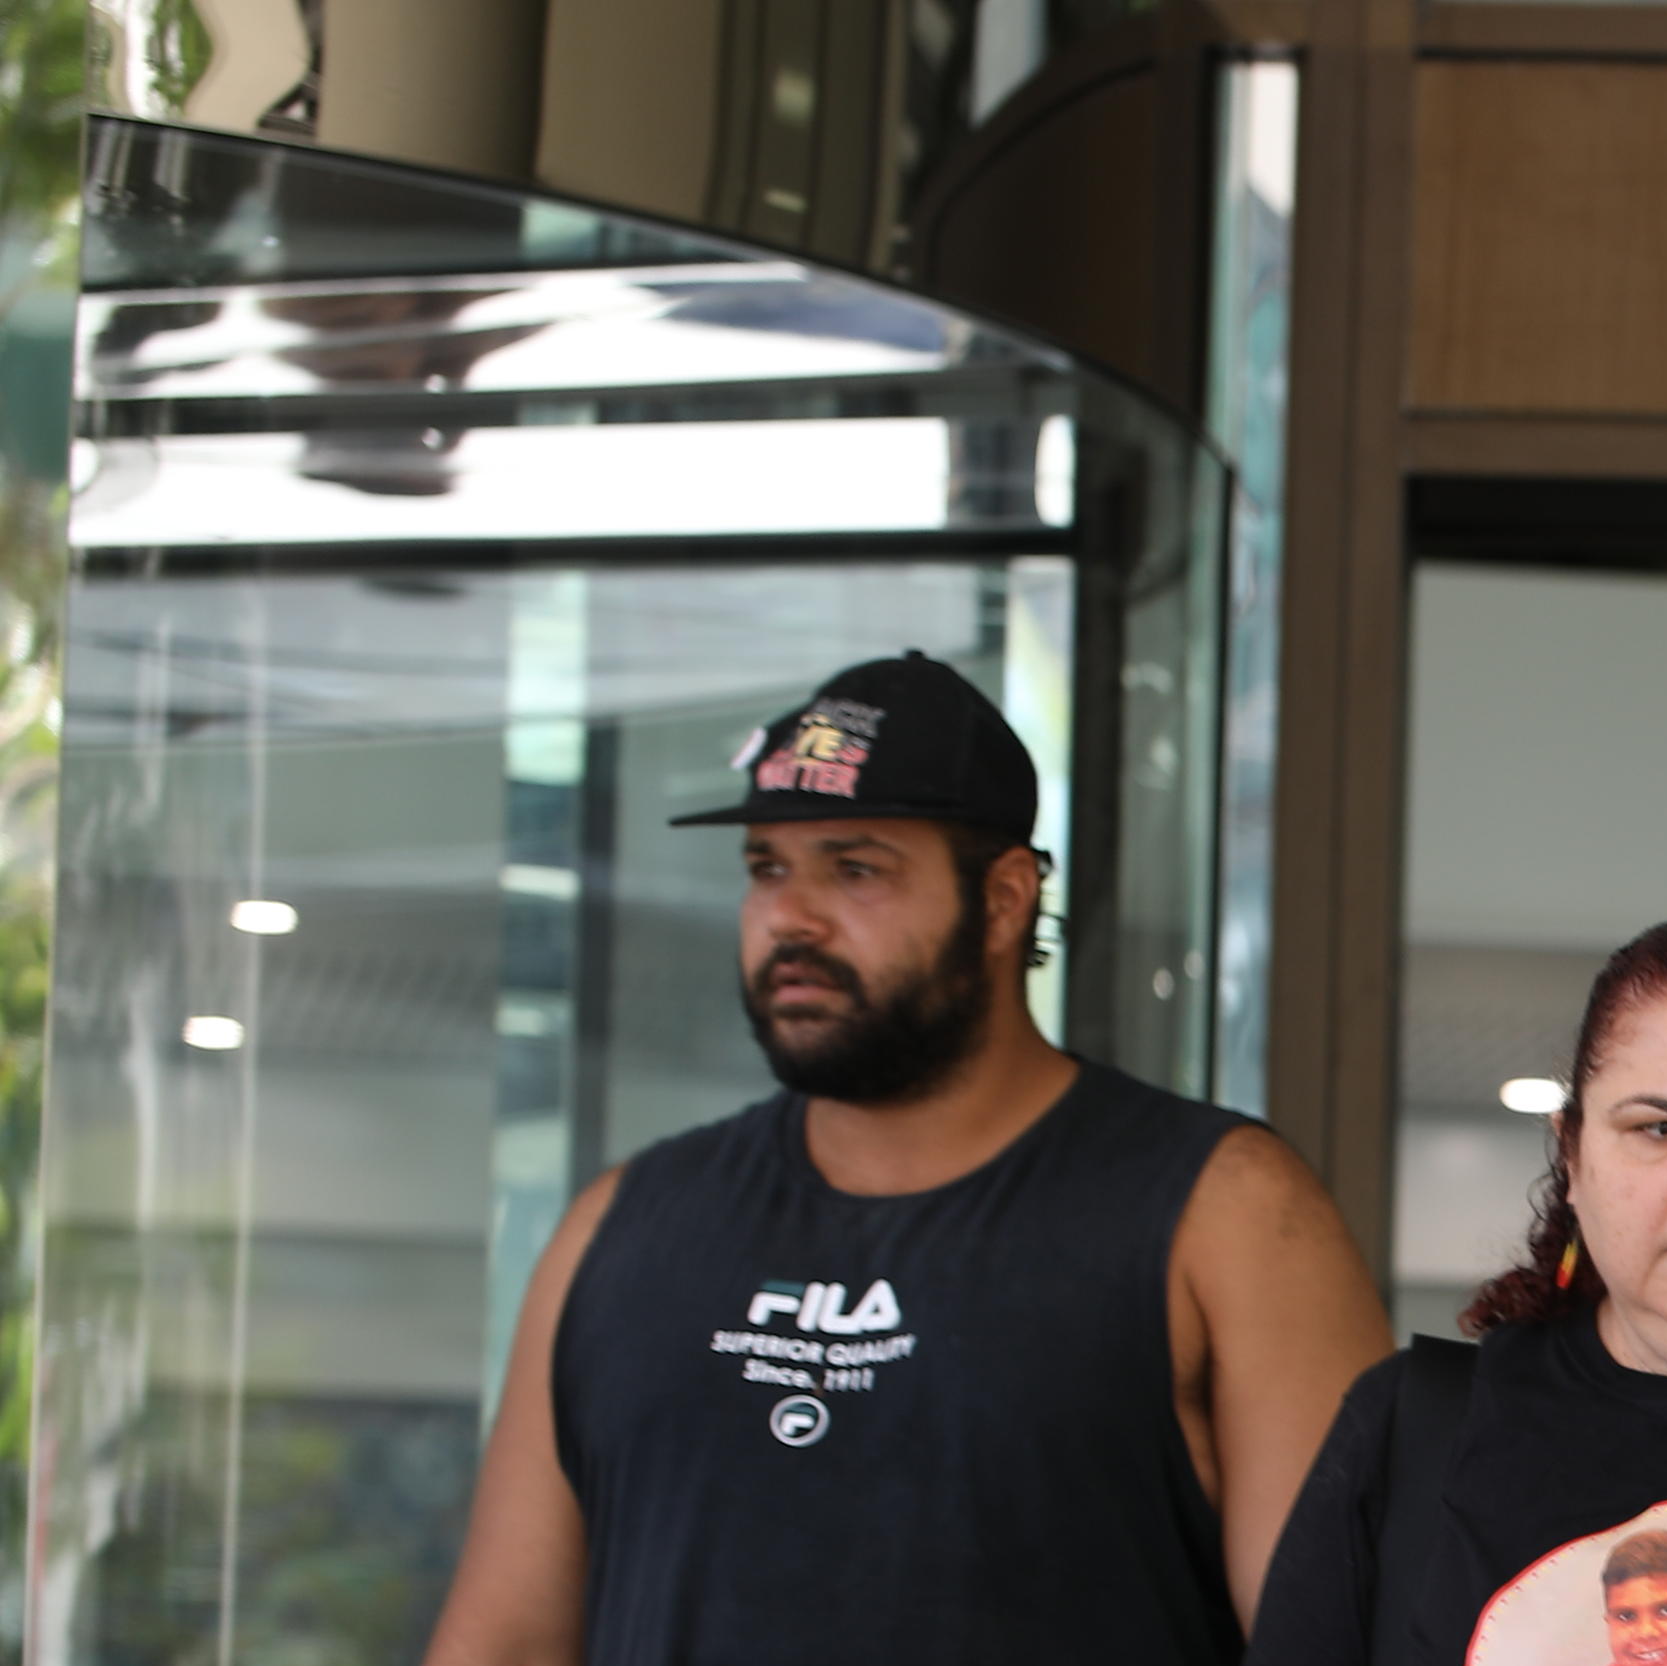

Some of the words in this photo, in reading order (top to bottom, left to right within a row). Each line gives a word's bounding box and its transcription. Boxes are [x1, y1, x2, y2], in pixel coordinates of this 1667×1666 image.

[747, 1278, 902, 1335] FILA
[710, 1329, 824, 1365] SUPERIOR
[825, 1333, 918, 1367] QUALITY
[823, 1367, 875, 1392] 1911
